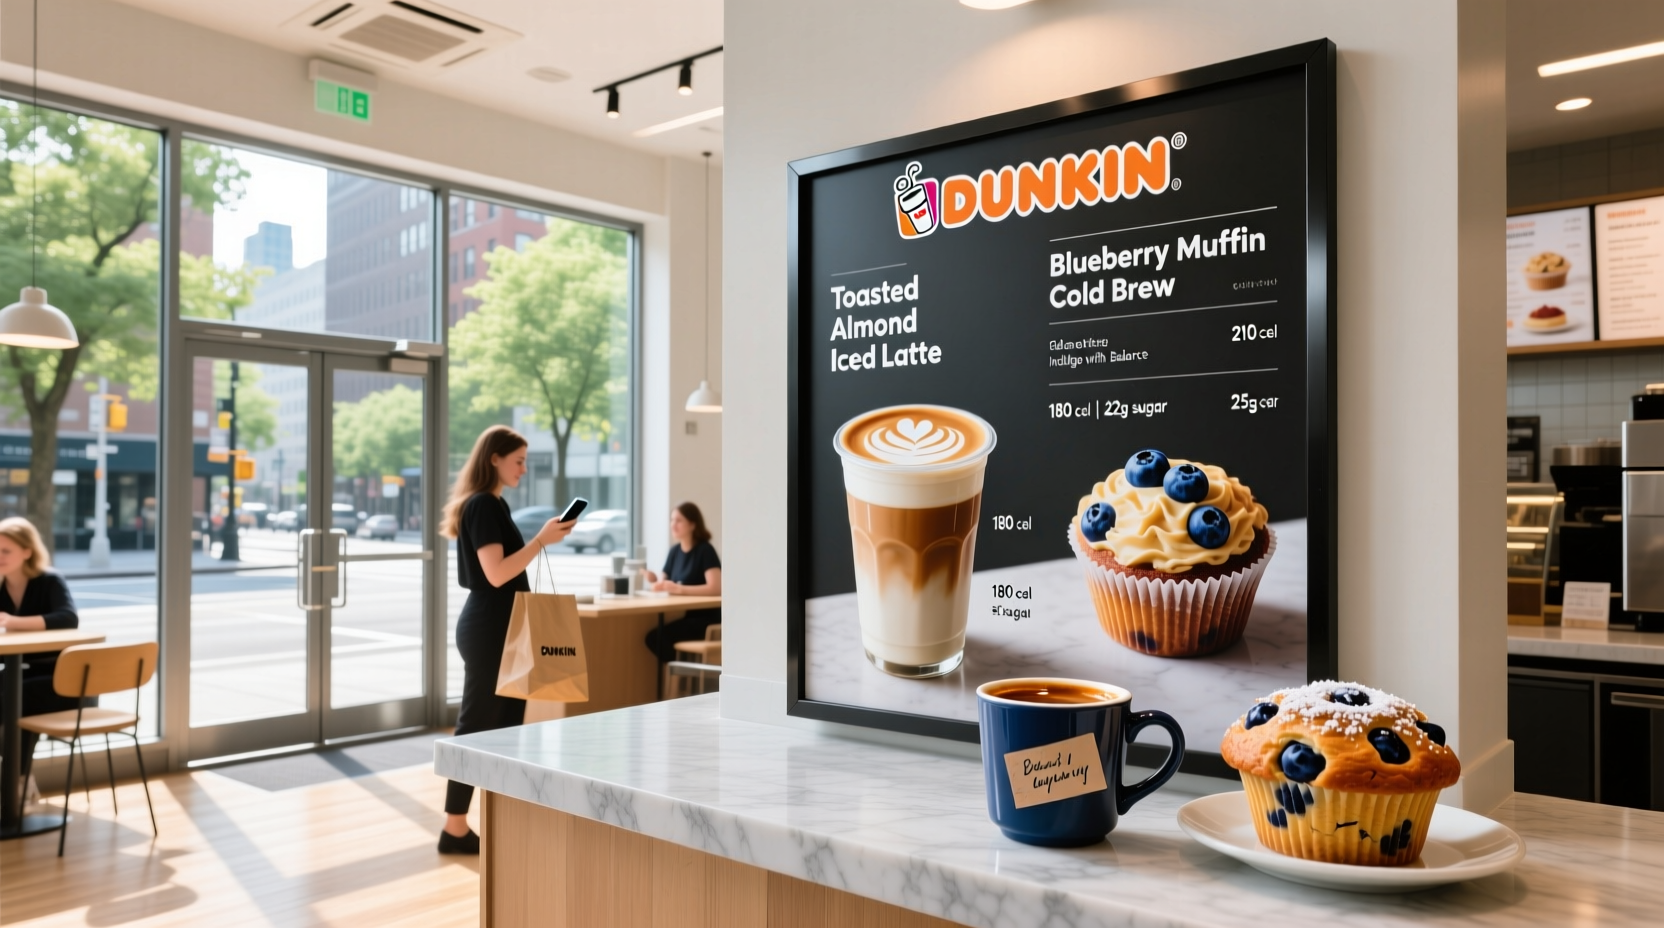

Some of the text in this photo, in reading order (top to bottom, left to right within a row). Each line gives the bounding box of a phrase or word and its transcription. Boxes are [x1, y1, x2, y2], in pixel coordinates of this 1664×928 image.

[941, 136, 1170, 229] DUNKIN
[1050, 226, 1266, 277] Blueberry Muffin
[831, 274, 918, 310] Toasted
[1050, 278, 1176, 309] Cold Brew
[830, 306, 917, 342] Almond
[1231, 323, 1257, 342] 210
[831, 341, 942, 373] Iced Latte
[1048, 401, 1073, 419] 180
[1103, 400, 1128, 419] 22g
[1131, 401, 1168, 418] sugar
[1230, 392, 1257, 413] 25g
[992, 515, 1014, 531] 180
[992, 584, 1013, 599] 180
